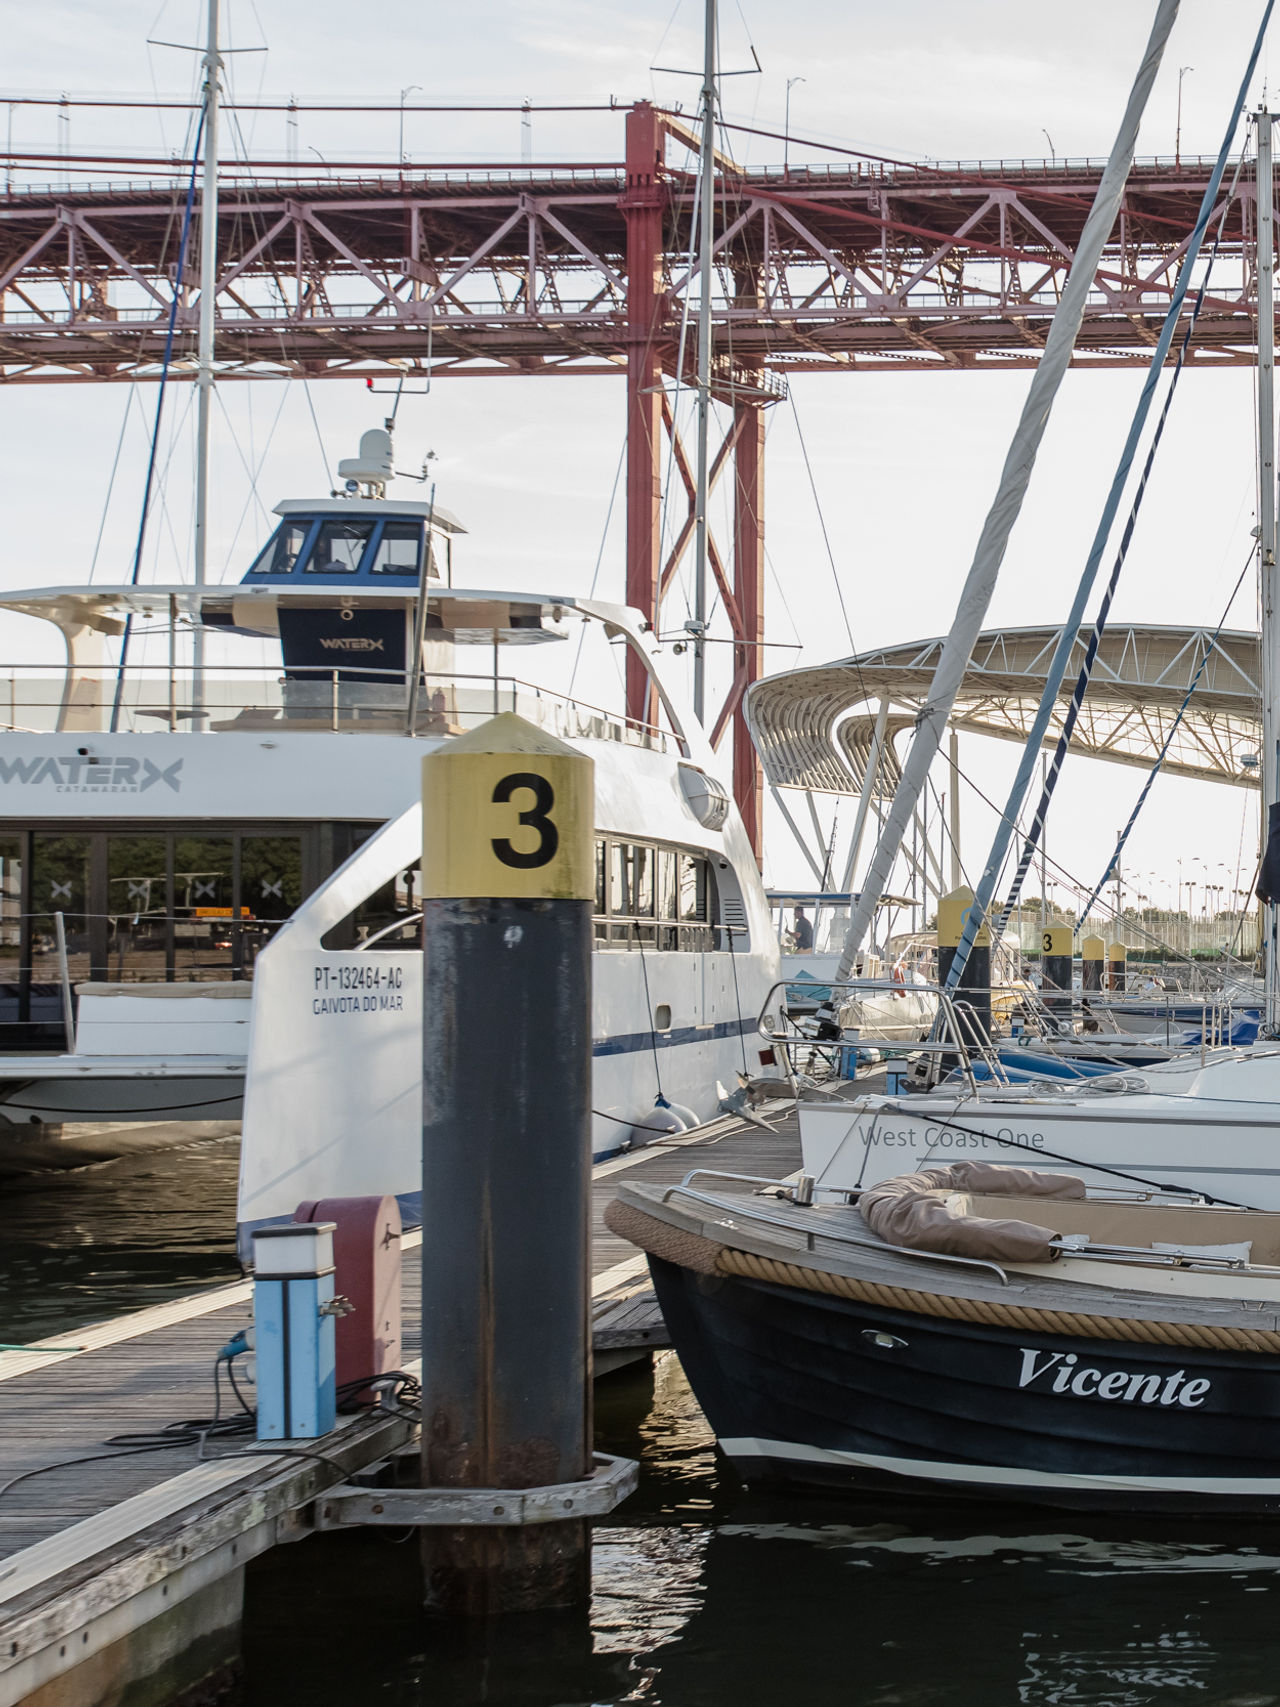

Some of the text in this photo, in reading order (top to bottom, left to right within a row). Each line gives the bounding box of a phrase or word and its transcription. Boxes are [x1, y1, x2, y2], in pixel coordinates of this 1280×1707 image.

[319, 637, 384, 652] WATERX
[0, 756, 184, 793] WATERX
[56, 785, 138, 793] CATAMARAN
[490, 771, 559, 870] 3
[1042, 933, 1053, 952] 3
[314, 966, 403, 990] PT-132464-AC
[313, 995, 404, 1015] GAIVOTA DO MAR
[858, 1125, 1045, 1149] West Coast One
[1018, 1348, 1211, 1407] Vicente
